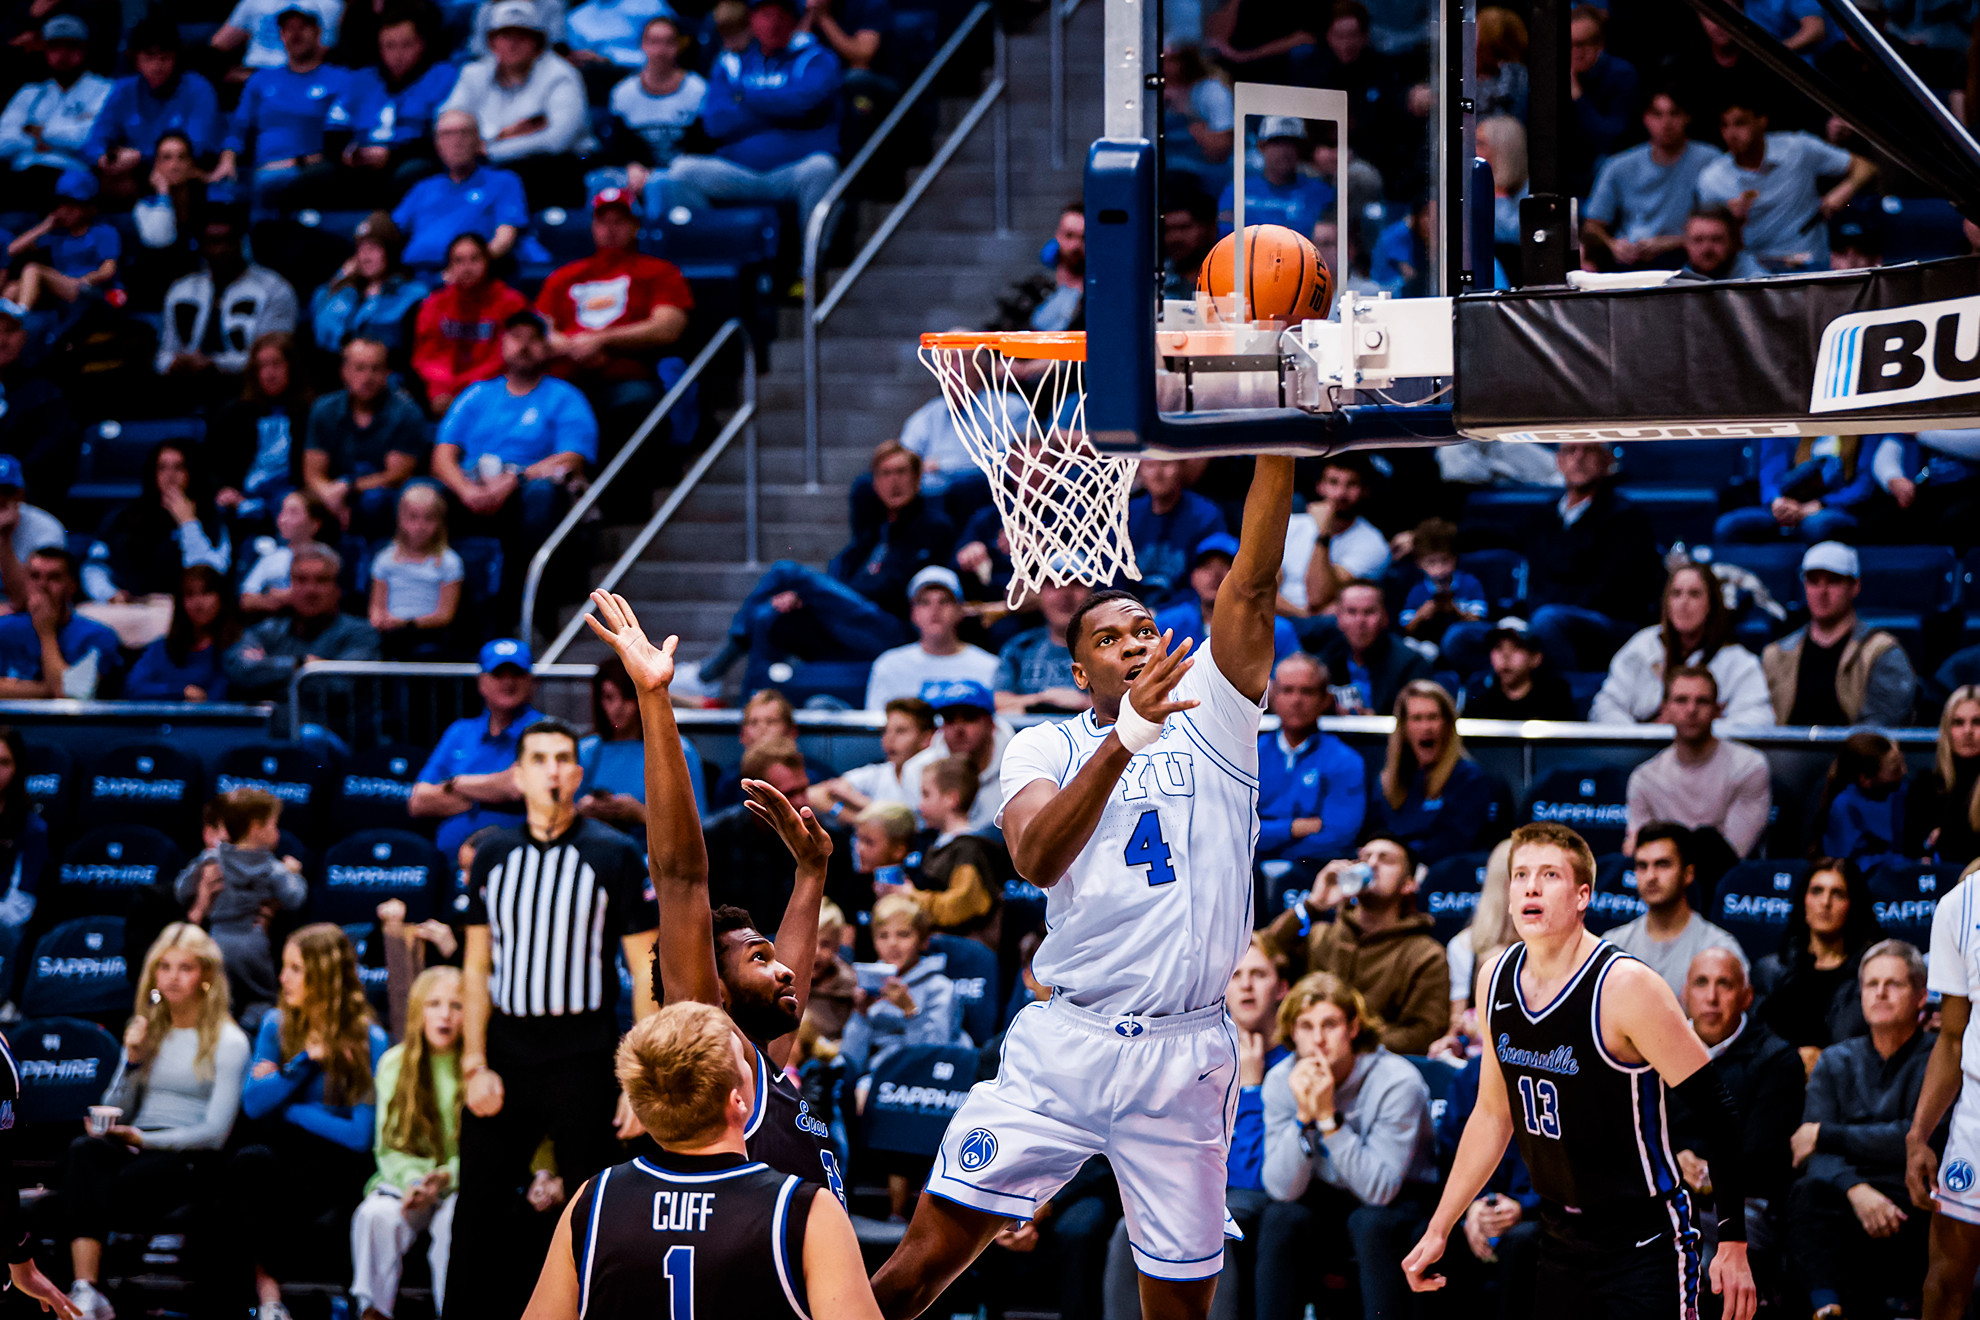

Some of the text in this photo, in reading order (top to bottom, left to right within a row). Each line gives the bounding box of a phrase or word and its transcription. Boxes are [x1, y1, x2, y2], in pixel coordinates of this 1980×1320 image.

[1532, 425, 1790, 440] BUILT
[1120, 752, 1195, 801] YU
[1124, 809, 1177, 887] 4
[37, 956, 127, 978] SAPPHIR
[20, 1058, 99, 1081] PPHIRE
[1497, 1032, 1579, 1075] Evansville
[1518, 1075, 1562, 1140] 13
[652, 1191, 716, 1231] CUFF
[663, 1245, 695, 1320] 1
